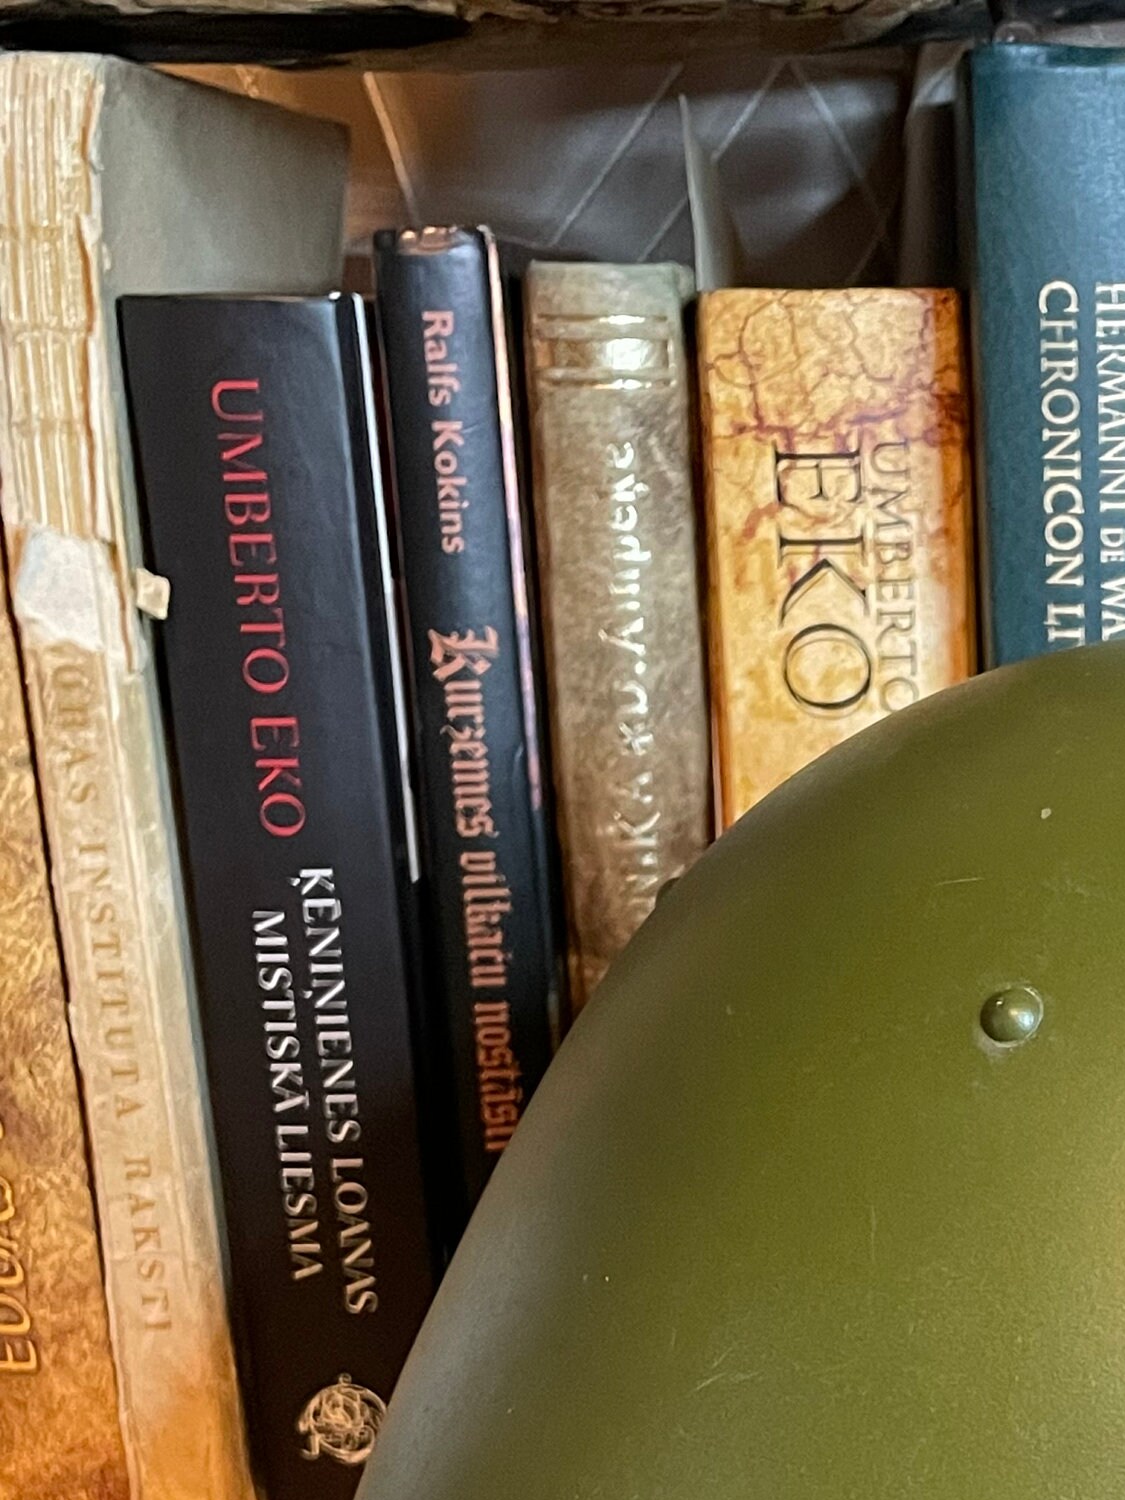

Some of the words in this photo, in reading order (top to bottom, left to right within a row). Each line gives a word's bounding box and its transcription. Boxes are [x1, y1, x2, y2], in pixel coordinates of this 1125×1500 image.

[422, 309, 461, 408] Ralfs
[1038, 280, 1085, 587] CHRONICON
[210, 378, 290, 694] UMBERTO
[250, 716, 307, 838] EKO
[431, 420, 470, 555] Kokins
[772, 439, 872, 712] EKO
[870, 439, 920, 712] UMBERTO
[428, 625, 499, 838] Kurzemes
[77, 841, 142, 1119] INSTITUTA
[123, 1156, 173, 1331] RAKSTI
[251, 910, 310, 1113] MISTISKĀ
[275, 1124, 324, 1281] LIESMA
